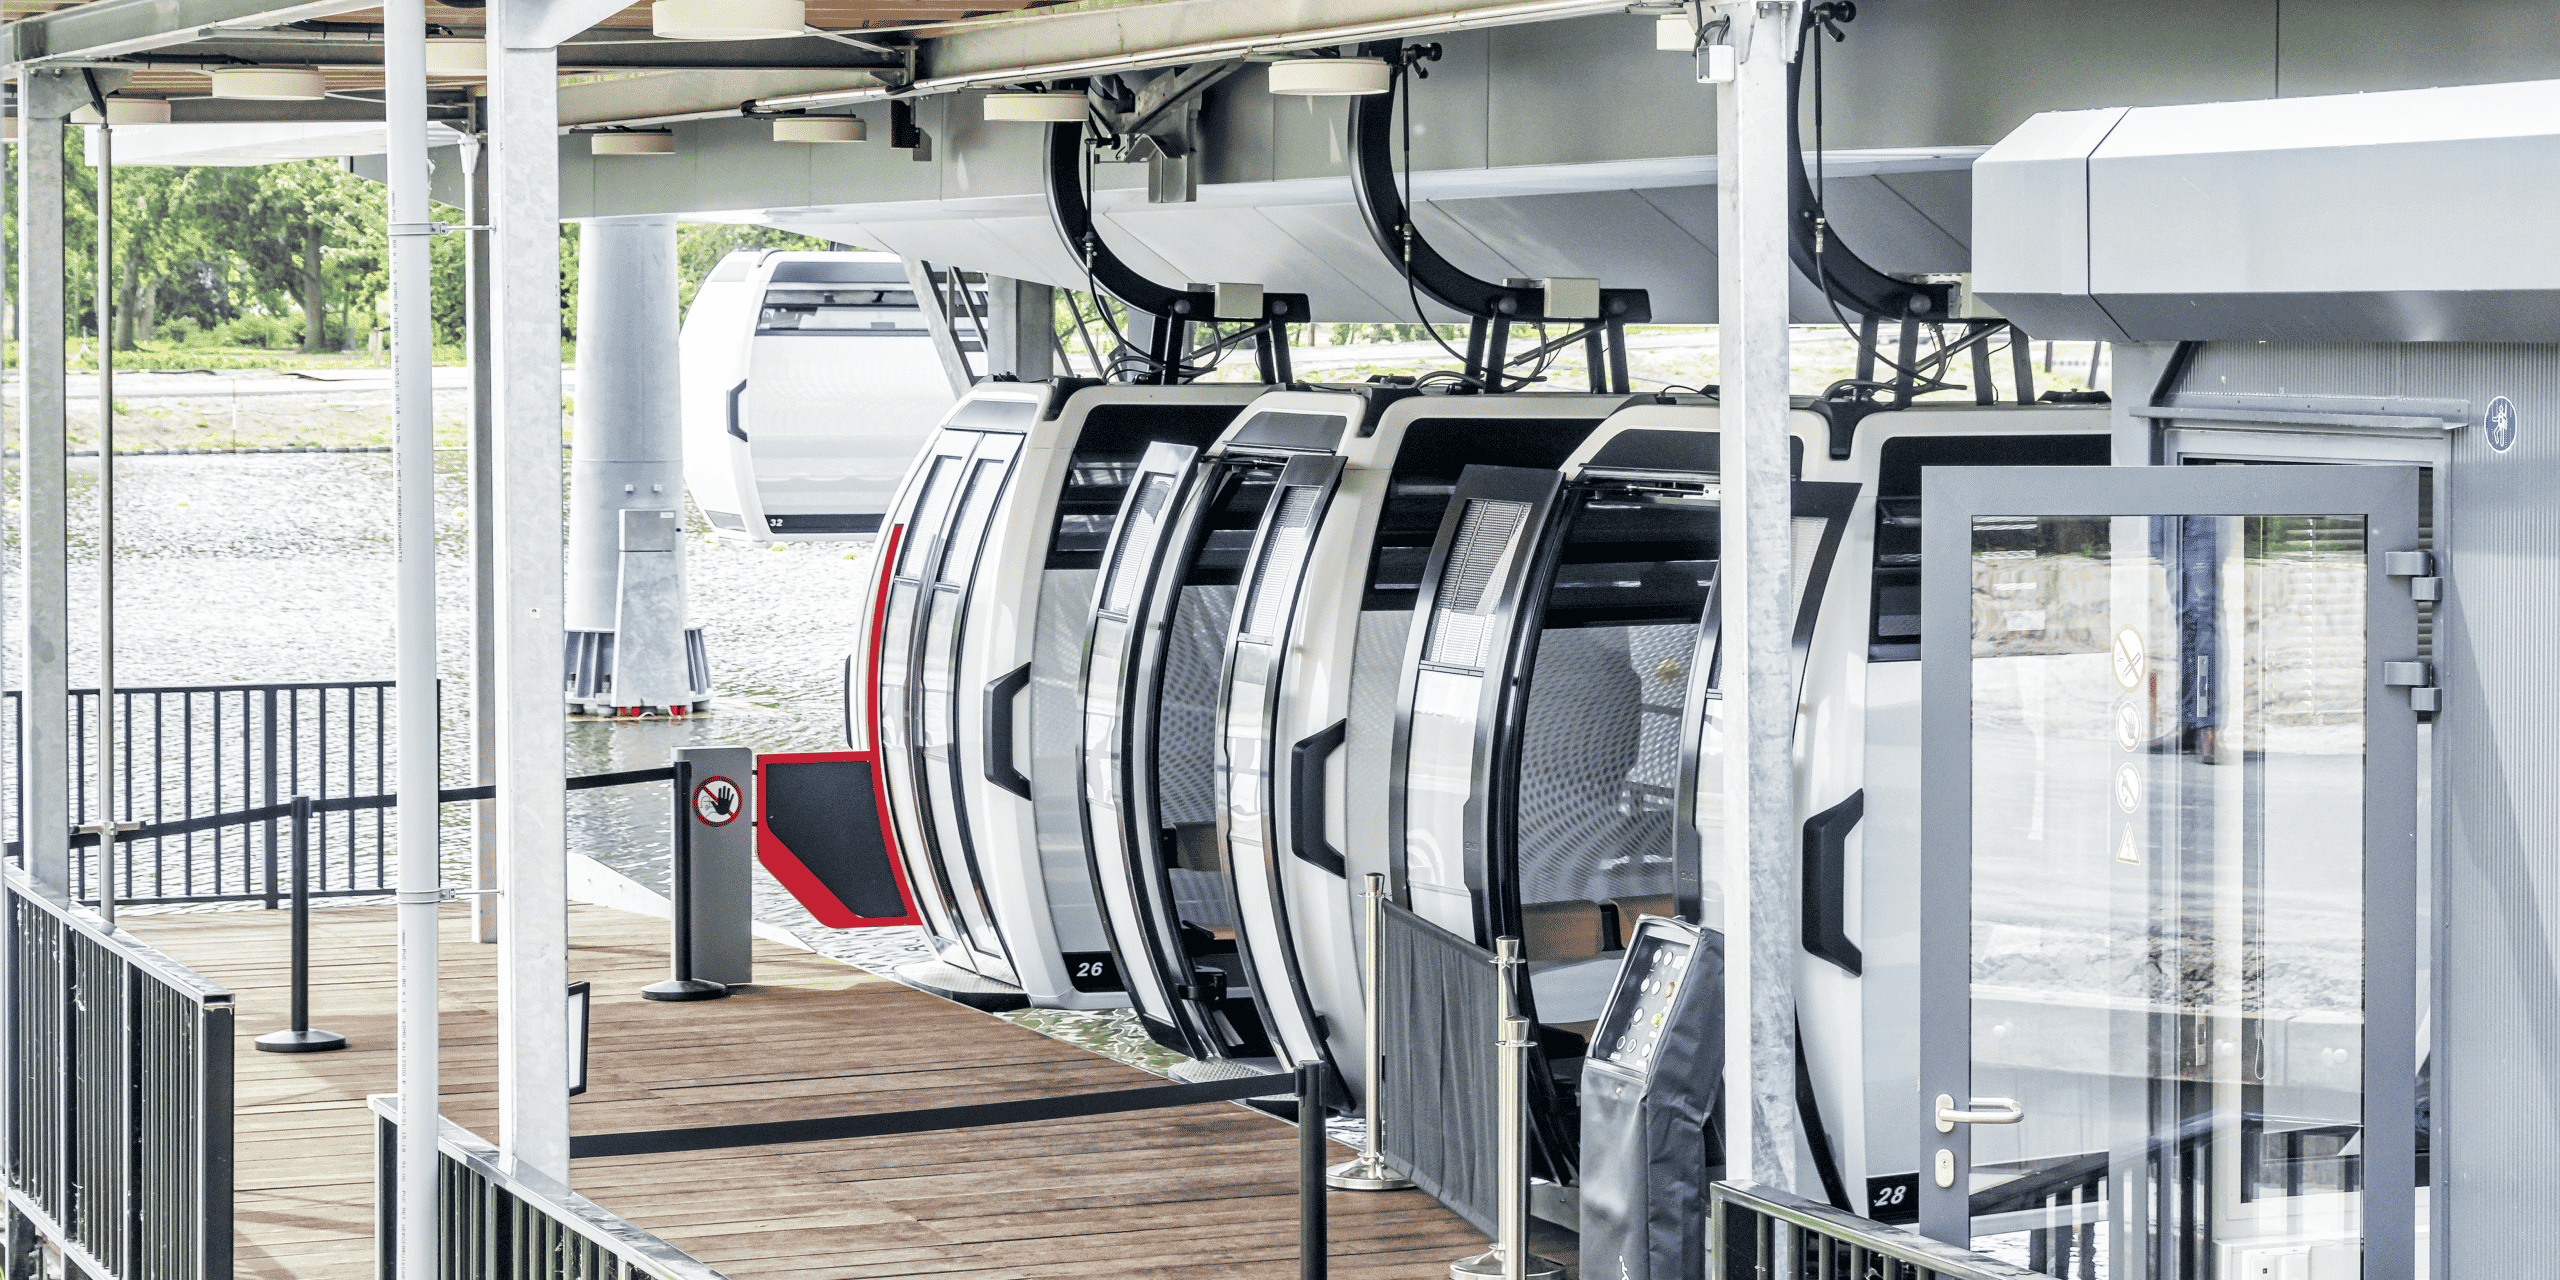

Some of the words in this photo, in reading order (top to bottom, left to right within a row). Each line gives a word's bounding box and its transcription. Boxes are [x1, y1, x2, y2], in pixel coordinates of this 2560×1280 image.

[769, 518, 784, 527] 32
[1076, 962, 1104, 977] 26
[1874, 1185, 1907, 1207] 28
